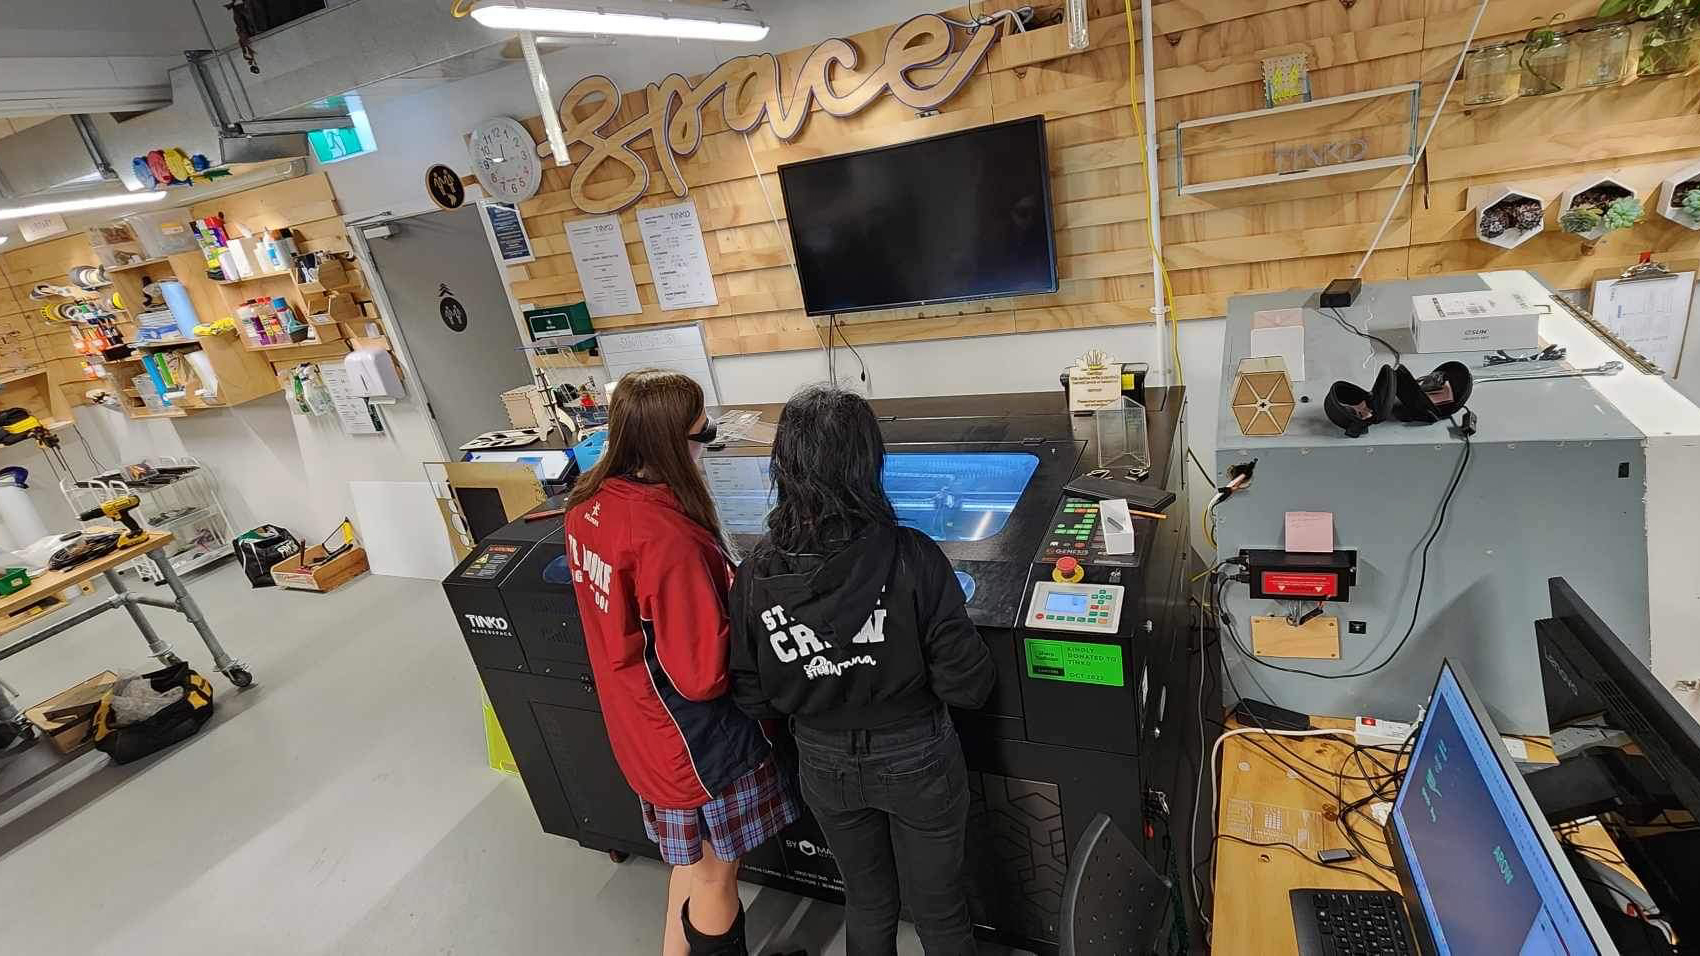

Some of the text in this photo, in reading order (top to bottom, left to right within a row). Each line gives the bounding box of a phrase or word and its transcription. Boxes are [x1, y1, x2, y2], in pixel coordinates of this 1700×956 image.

[538, 14, 997, 214] space
[770, 609, 887, 663] CRW
[1068, 653, 1105, 662] DONATED
